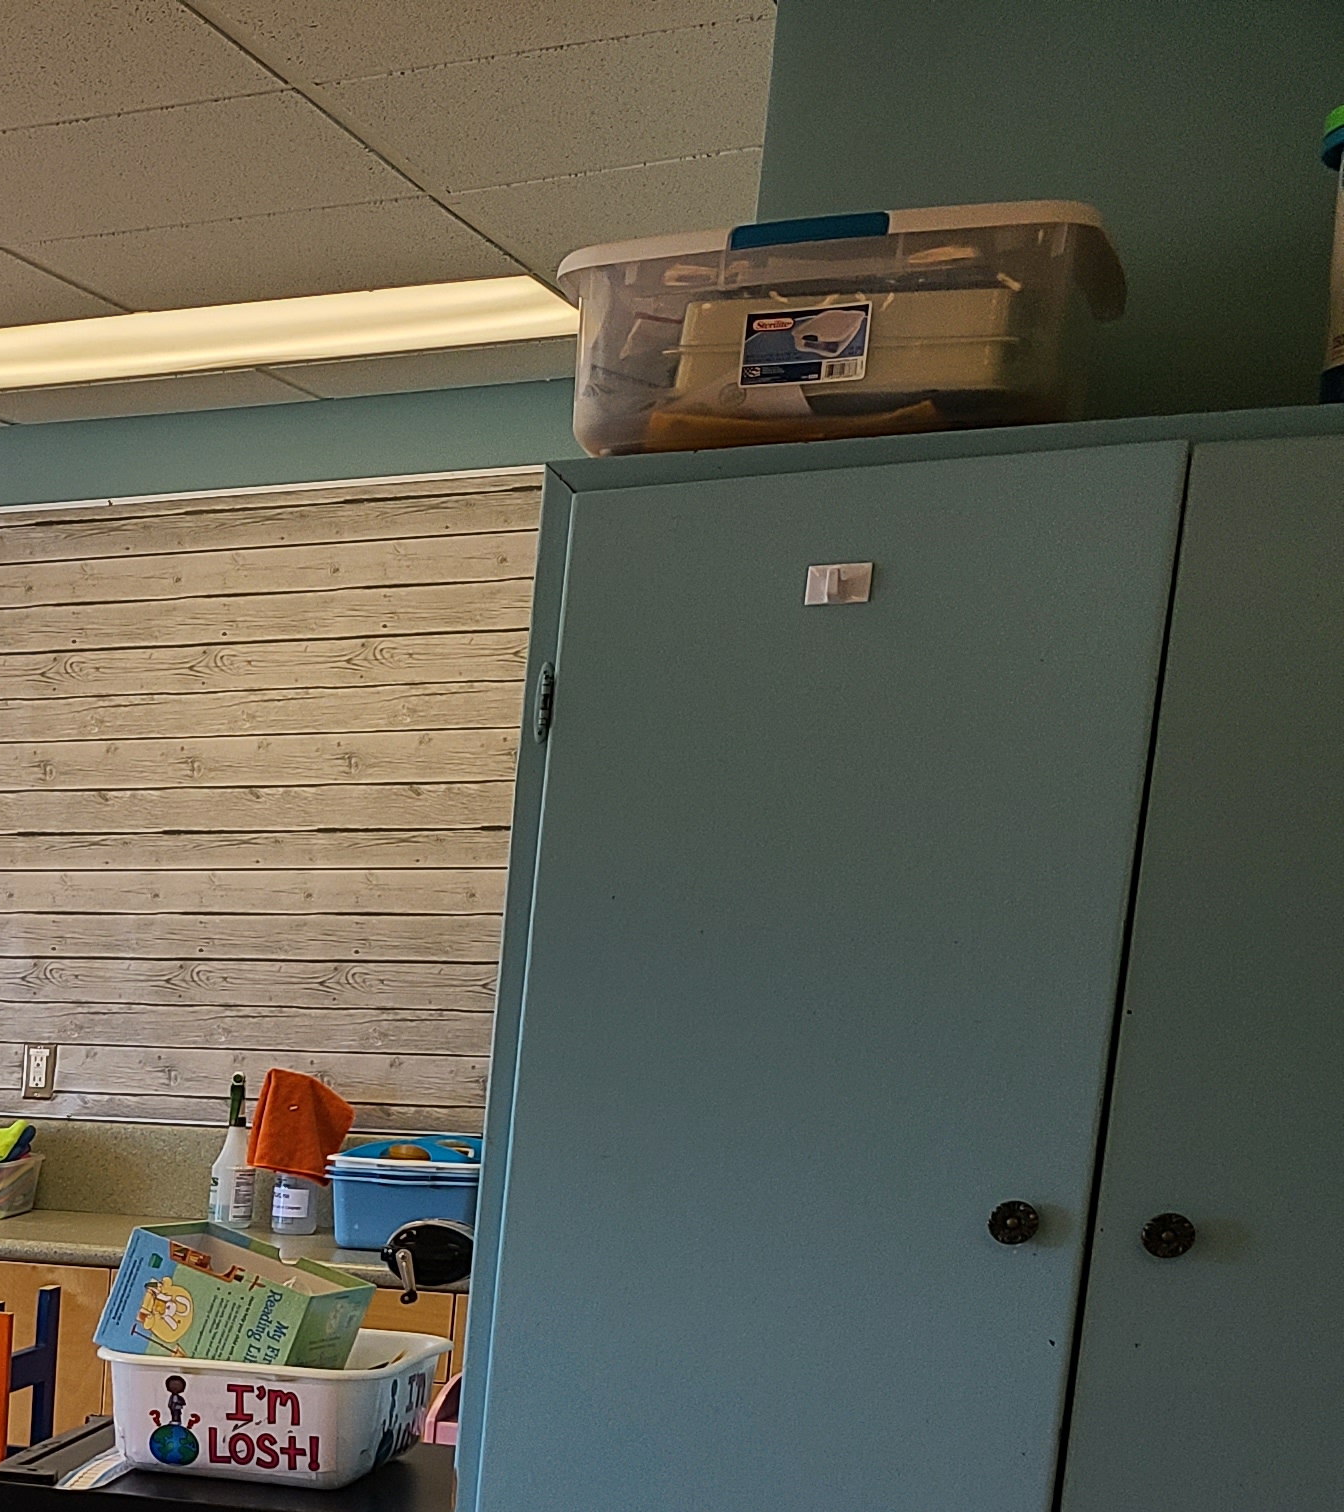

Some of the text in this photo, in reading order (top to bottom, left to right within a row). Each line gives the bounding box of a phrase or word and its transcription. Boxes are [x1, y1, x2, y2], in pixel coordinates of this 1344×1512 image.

[756, 320, 789, 330] Sterilite
[246, 1289, 283, 1342] Reading
[262, 1320, 290, 1365] My Fir
[225, 1383, 301, 1426] I'm
